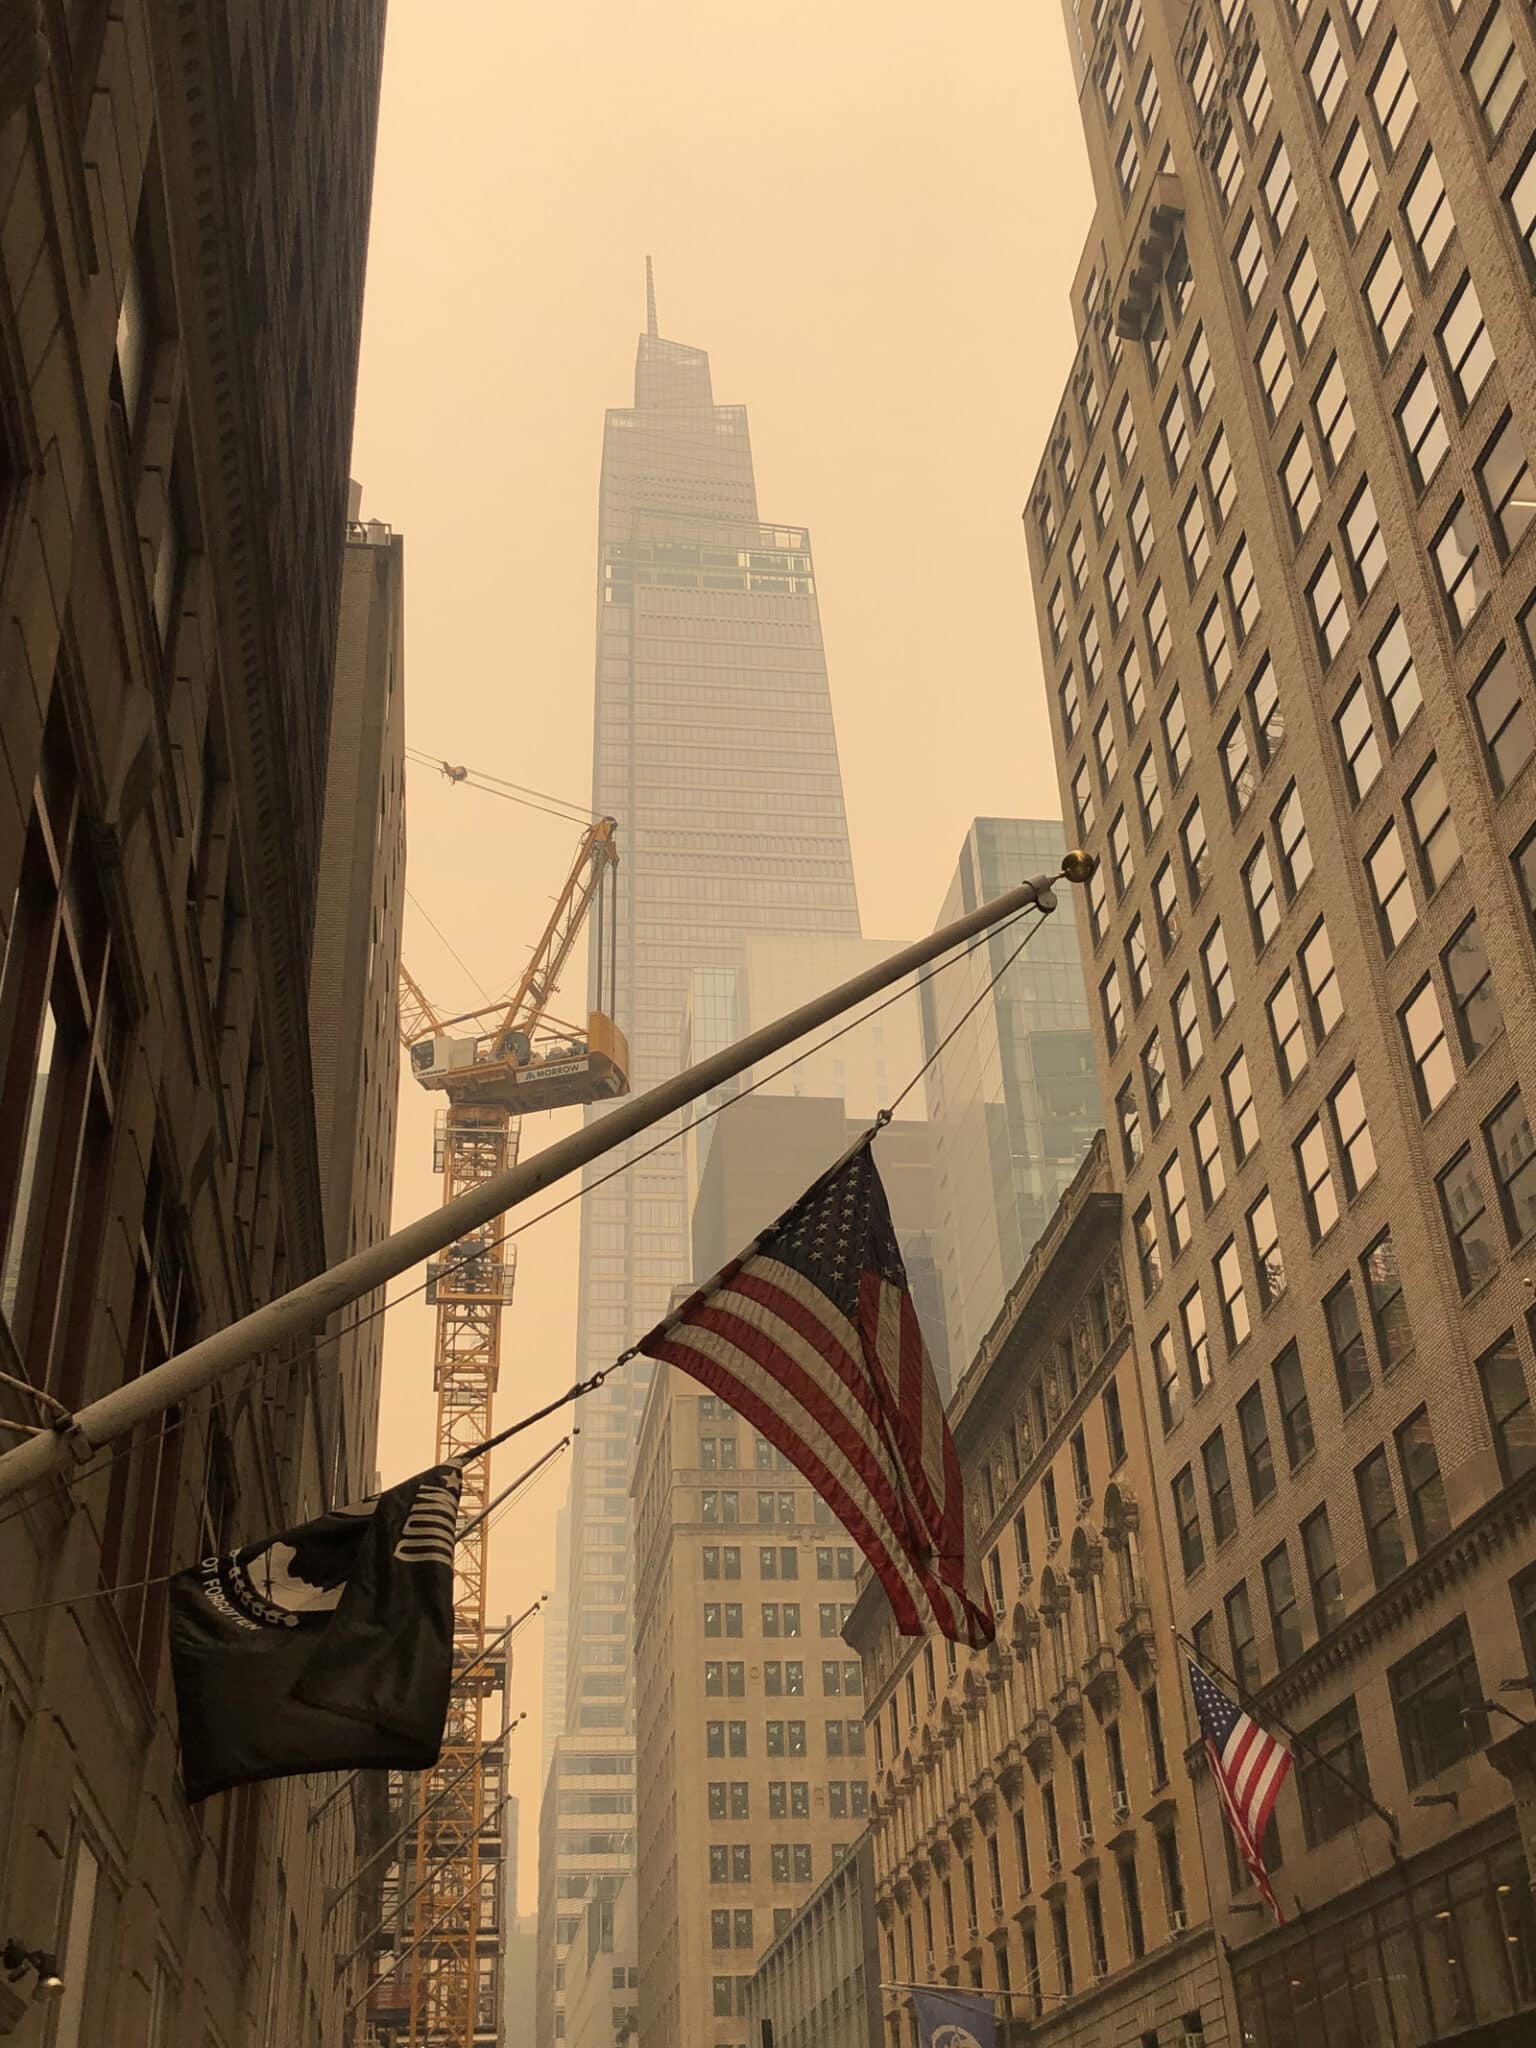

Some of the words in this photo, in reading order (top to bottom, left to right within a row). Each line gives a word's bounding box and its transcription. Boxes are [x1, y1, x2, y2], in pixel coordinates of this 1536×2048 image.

[536, 1063, 580, 1078] MORROW
[200, 1556, 219, 1574] OT
[202, 1578, 264, 1630] FORGOTTEN
